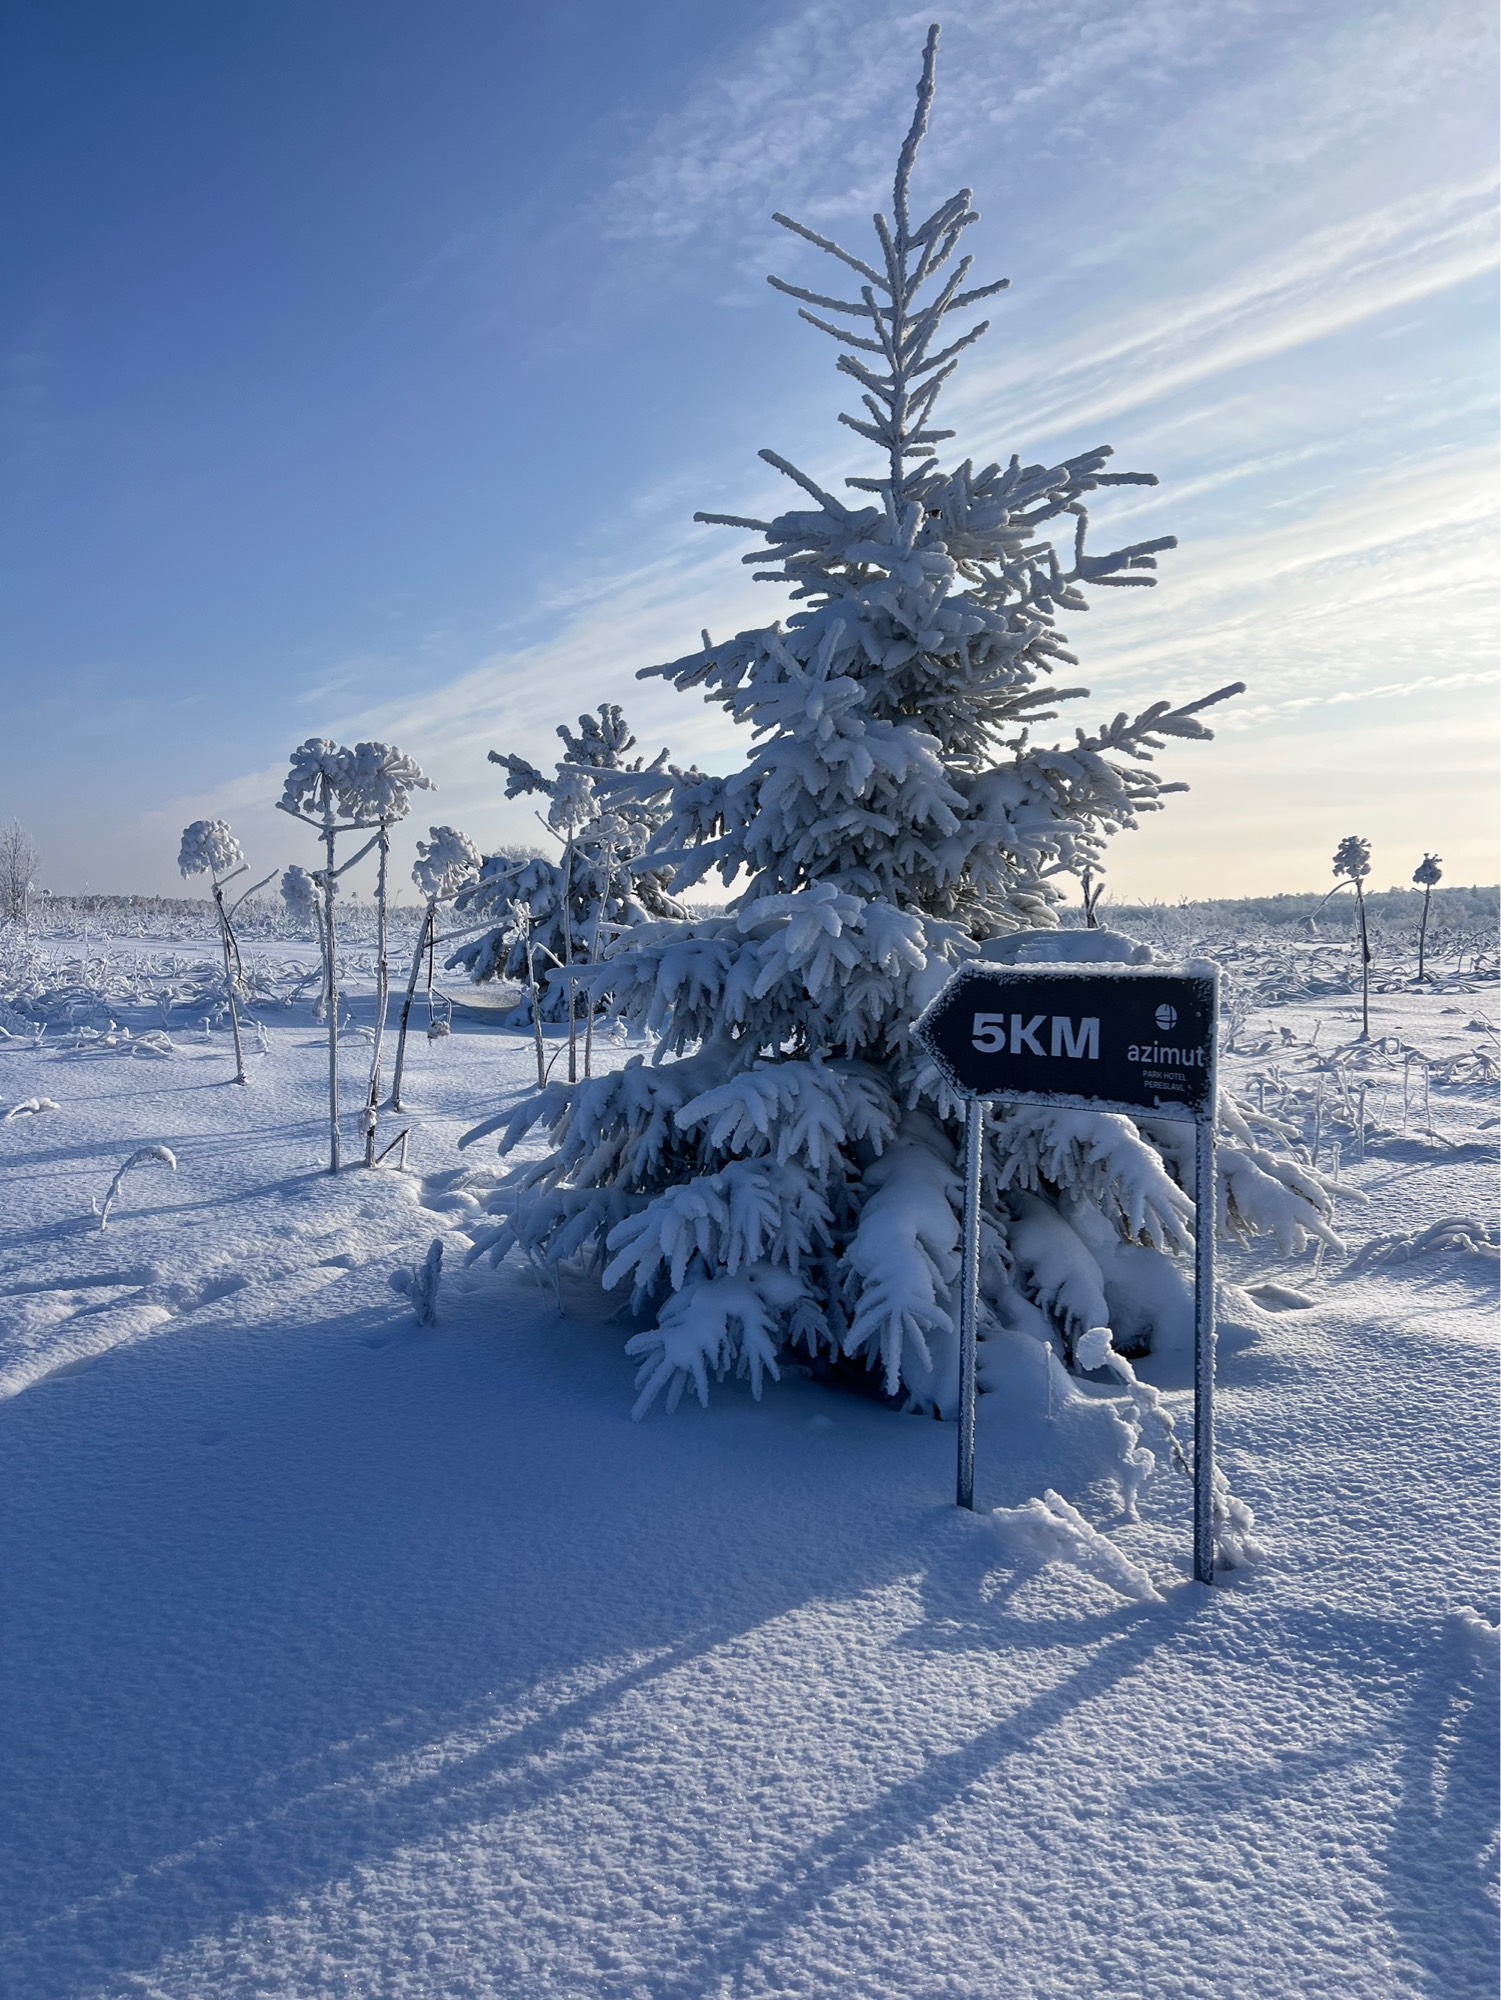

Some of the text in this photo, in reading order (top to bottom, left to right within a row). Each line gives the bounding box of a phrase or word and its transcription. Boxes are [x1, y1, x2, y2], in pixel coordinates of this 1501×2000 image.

[971, 1012, 1100, 1060] 5KM
[1127, 1040, 1204, 1067] azimut
[1143, 1070, 1187, 1081] PARK HOTEL
[1144, 1080, 1186, 1091] PERESLAVL
